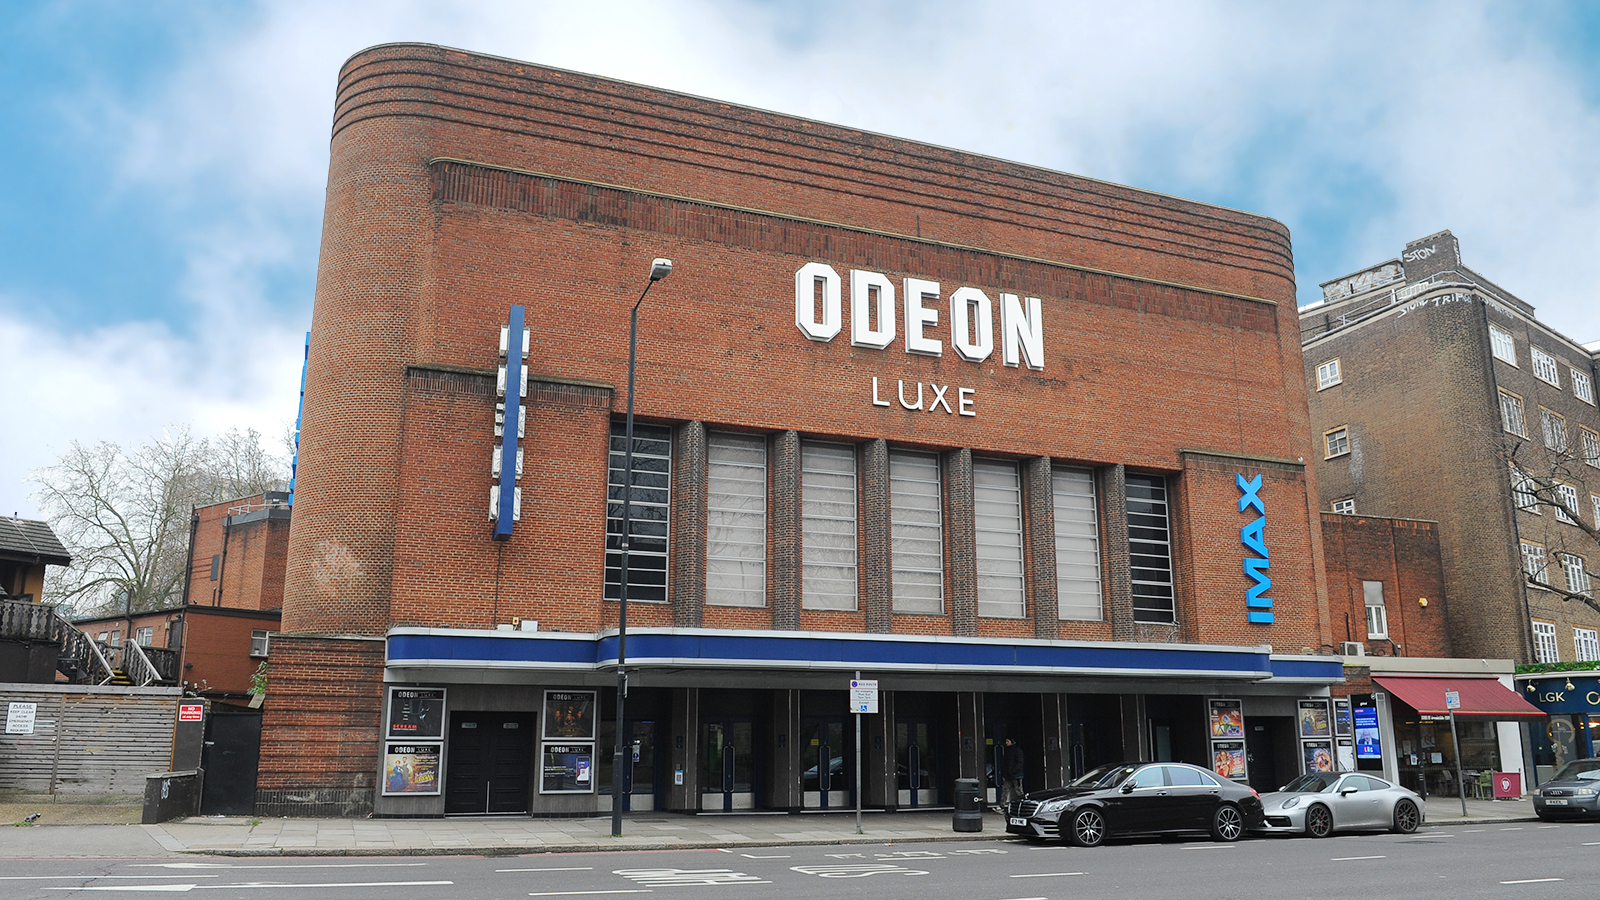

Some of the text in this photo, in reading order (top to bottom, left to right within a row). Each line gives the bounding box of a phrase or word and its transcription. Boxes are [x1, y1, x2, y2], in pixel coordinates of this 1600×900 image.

[795, 262, 1045, 371] ODEON
[872, 376, 976, 417] LUXE
[1235, 473, 1275, 623] IMAX
[1539, 692, 1565, 702] LGK
